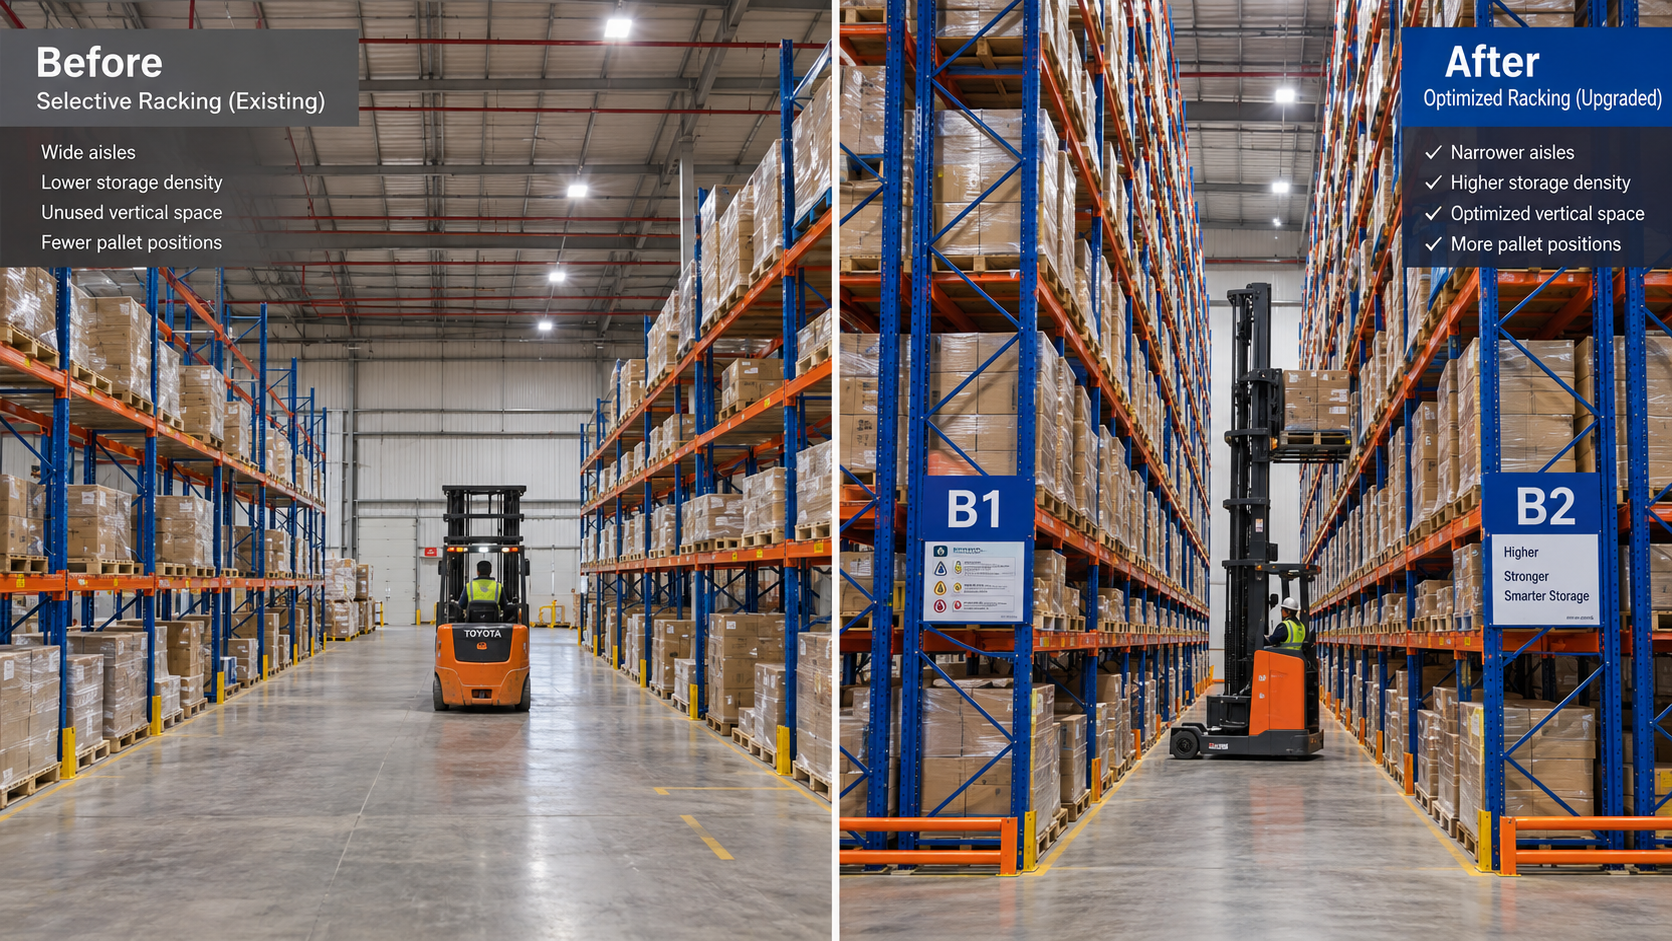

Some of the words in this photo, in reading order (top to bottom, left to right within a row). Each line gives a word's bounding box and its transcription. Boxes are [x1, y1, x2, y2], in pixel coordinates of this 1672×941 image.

[948, 489, 1000, 528] B1
[1517, 487, 1576, 526] B2
[1504, 545, 1539, 560] Higher
[1504, 570, 1549, 584] Stronger
[1504, 589, 1546, 602] Smarter
[1549, 589, 1590, 604] Storage
[463, 629, 502, 638] TOYOTA
